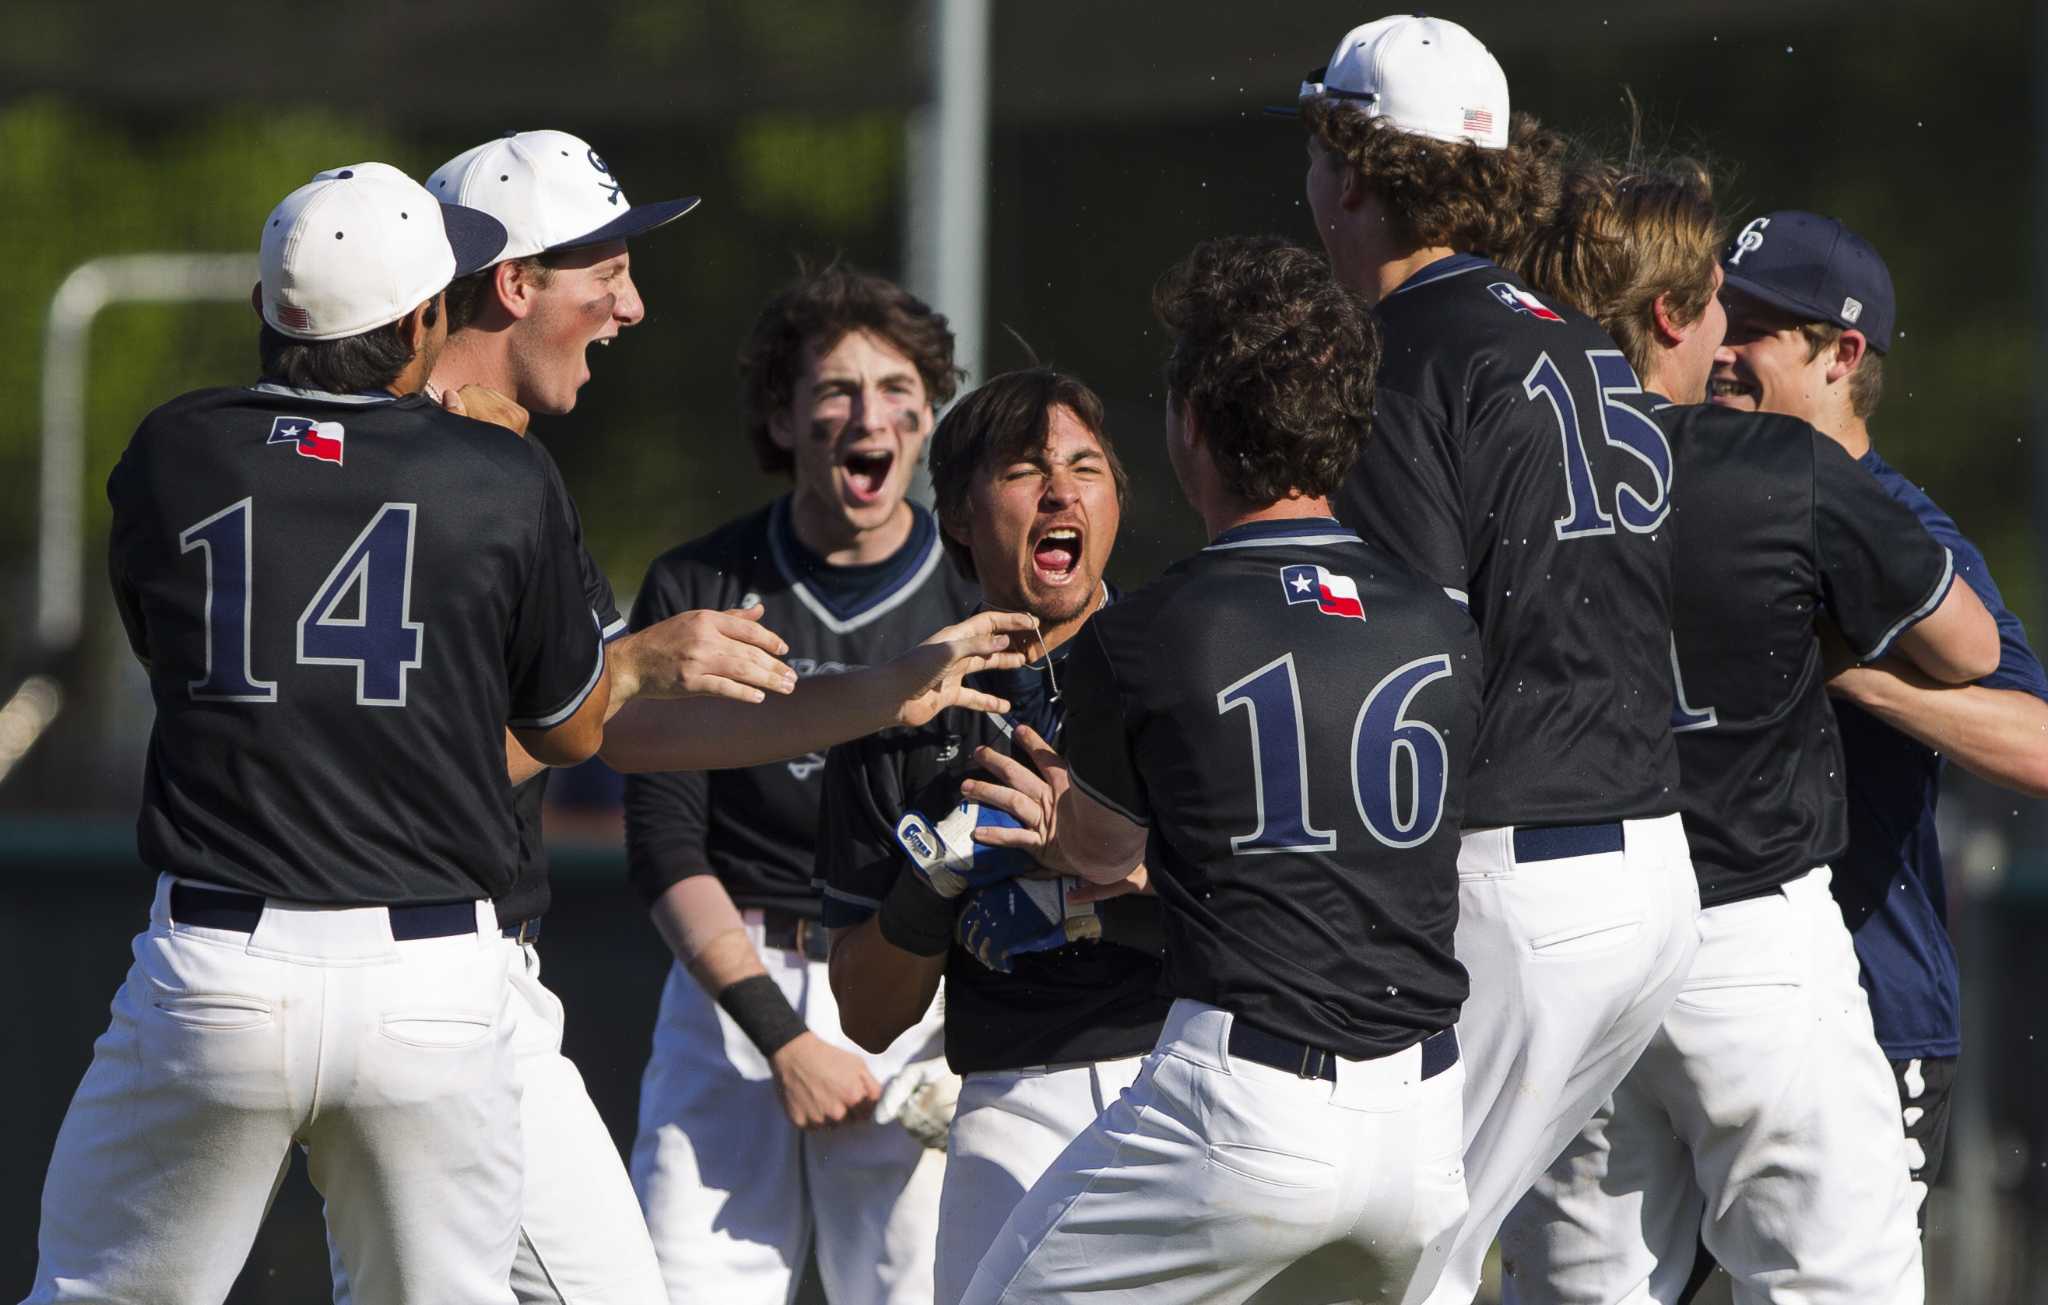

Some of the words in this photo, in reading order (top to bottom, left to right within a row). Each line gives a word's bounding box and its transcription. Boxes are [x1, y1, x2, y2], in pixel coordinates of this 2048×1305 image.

[1522, 350, 1673, 540] 15
[179, 496, 424, 706] 14
[1216, 651, 1453, 856] 16
